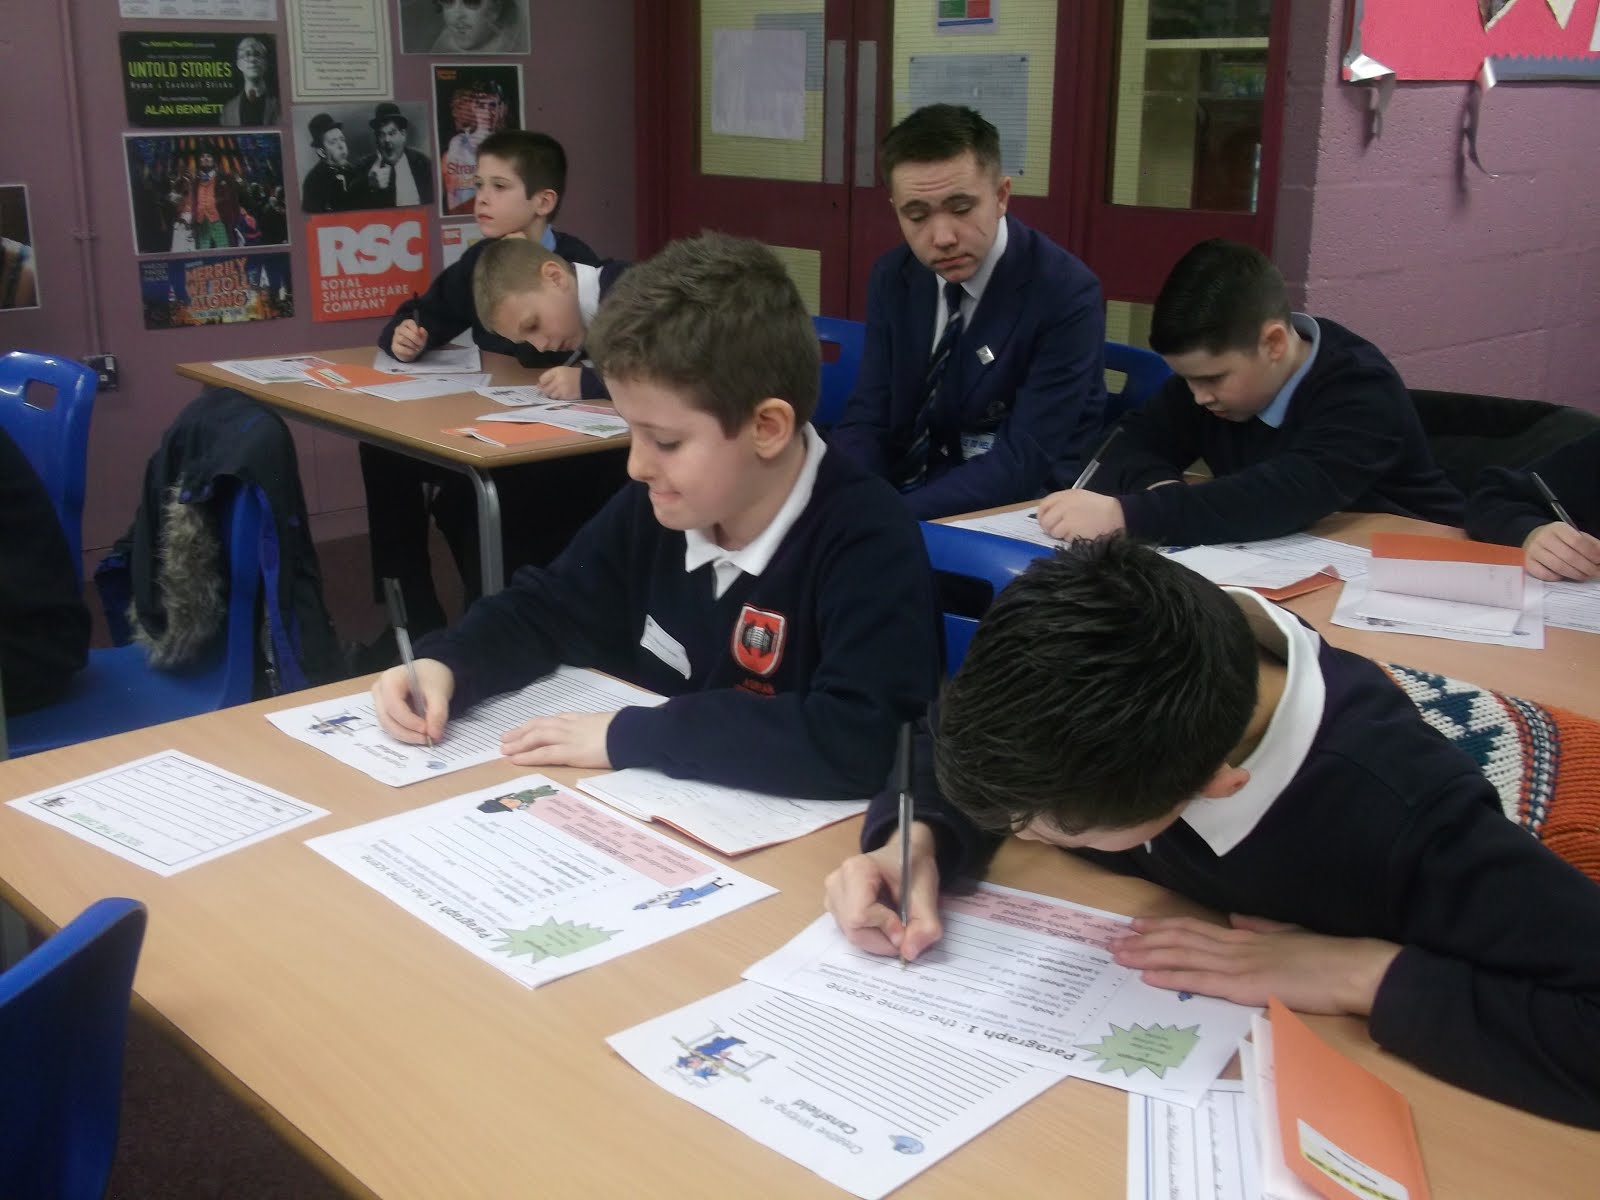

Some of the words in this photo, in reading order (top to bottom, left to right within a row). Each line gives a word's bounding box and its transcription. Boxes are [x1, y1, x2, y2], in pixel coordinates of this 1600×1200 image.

[128, 61, 178, 78] UNTOLD
[180, 61, 233, 78] STORIES
[144, 104, 174, 115] ALAN
[175, 103, 225, 115] BENNETT
[317, 220, 424, 277] RSC
[320, 278, 361, 290] ROYAL
[322, 284, 409, 302] SHAKESPEARE
[323, 298, 386, 313] COMPANY
[360, 855, 390, 872] scene
[386, 871, 415, 888] crime
[411, 888, 432, 900] the
[438, 905, 493, 939] Paragraph
[825, 982, 873, 1001] scene
[876, 999, 925, 1018] crime
[928, 1015, 958, 1029] the
[983, 1029, 1077, 1061] Paragraph
[791, 1099, 858, 1134] Cansfield
[816, 1127, 863, 1155] Creative
